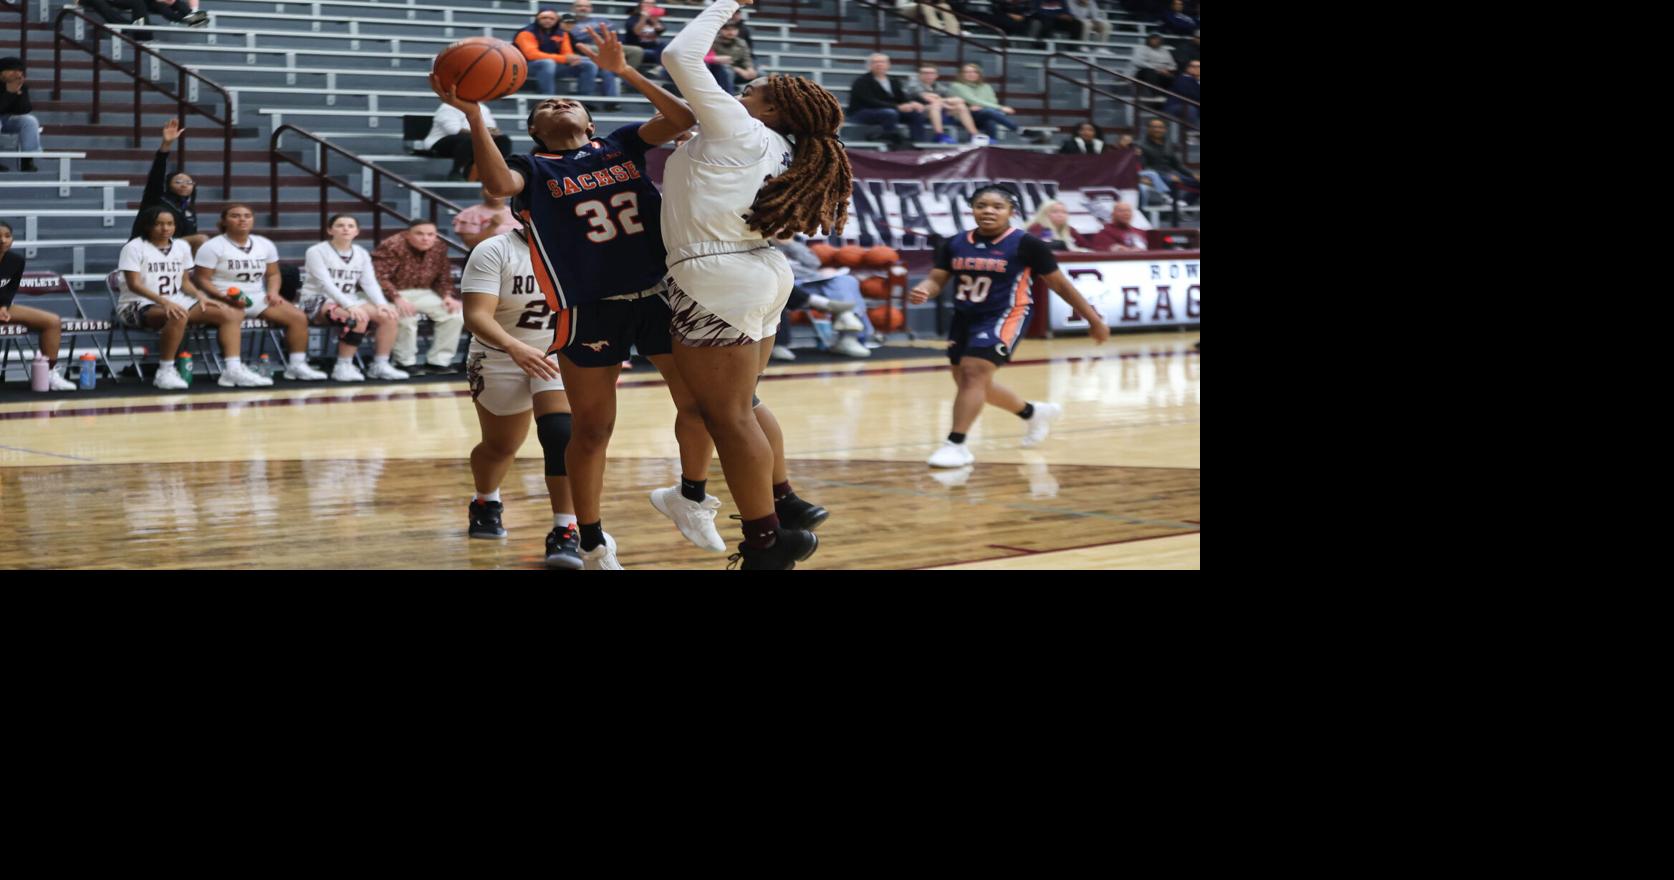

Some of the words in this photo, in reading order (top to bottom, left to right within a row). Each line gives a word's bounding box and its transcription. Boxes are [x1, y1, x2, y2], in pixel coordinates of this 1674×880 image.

[546, 161, 640, 198] SACHSE
[575, 191, 644, 243] 32
[148, 262, 182, 272] ROWLET
[228, 260, 264, 270] ROWLET
[1150, 264, 1199, 279] ROW
[19, 276, 60, 288] OWLETT
[158, 276, 178, 294] 21
[956, 275, 992, 303] 20
[67, 321, 109, 331] EAGLES
